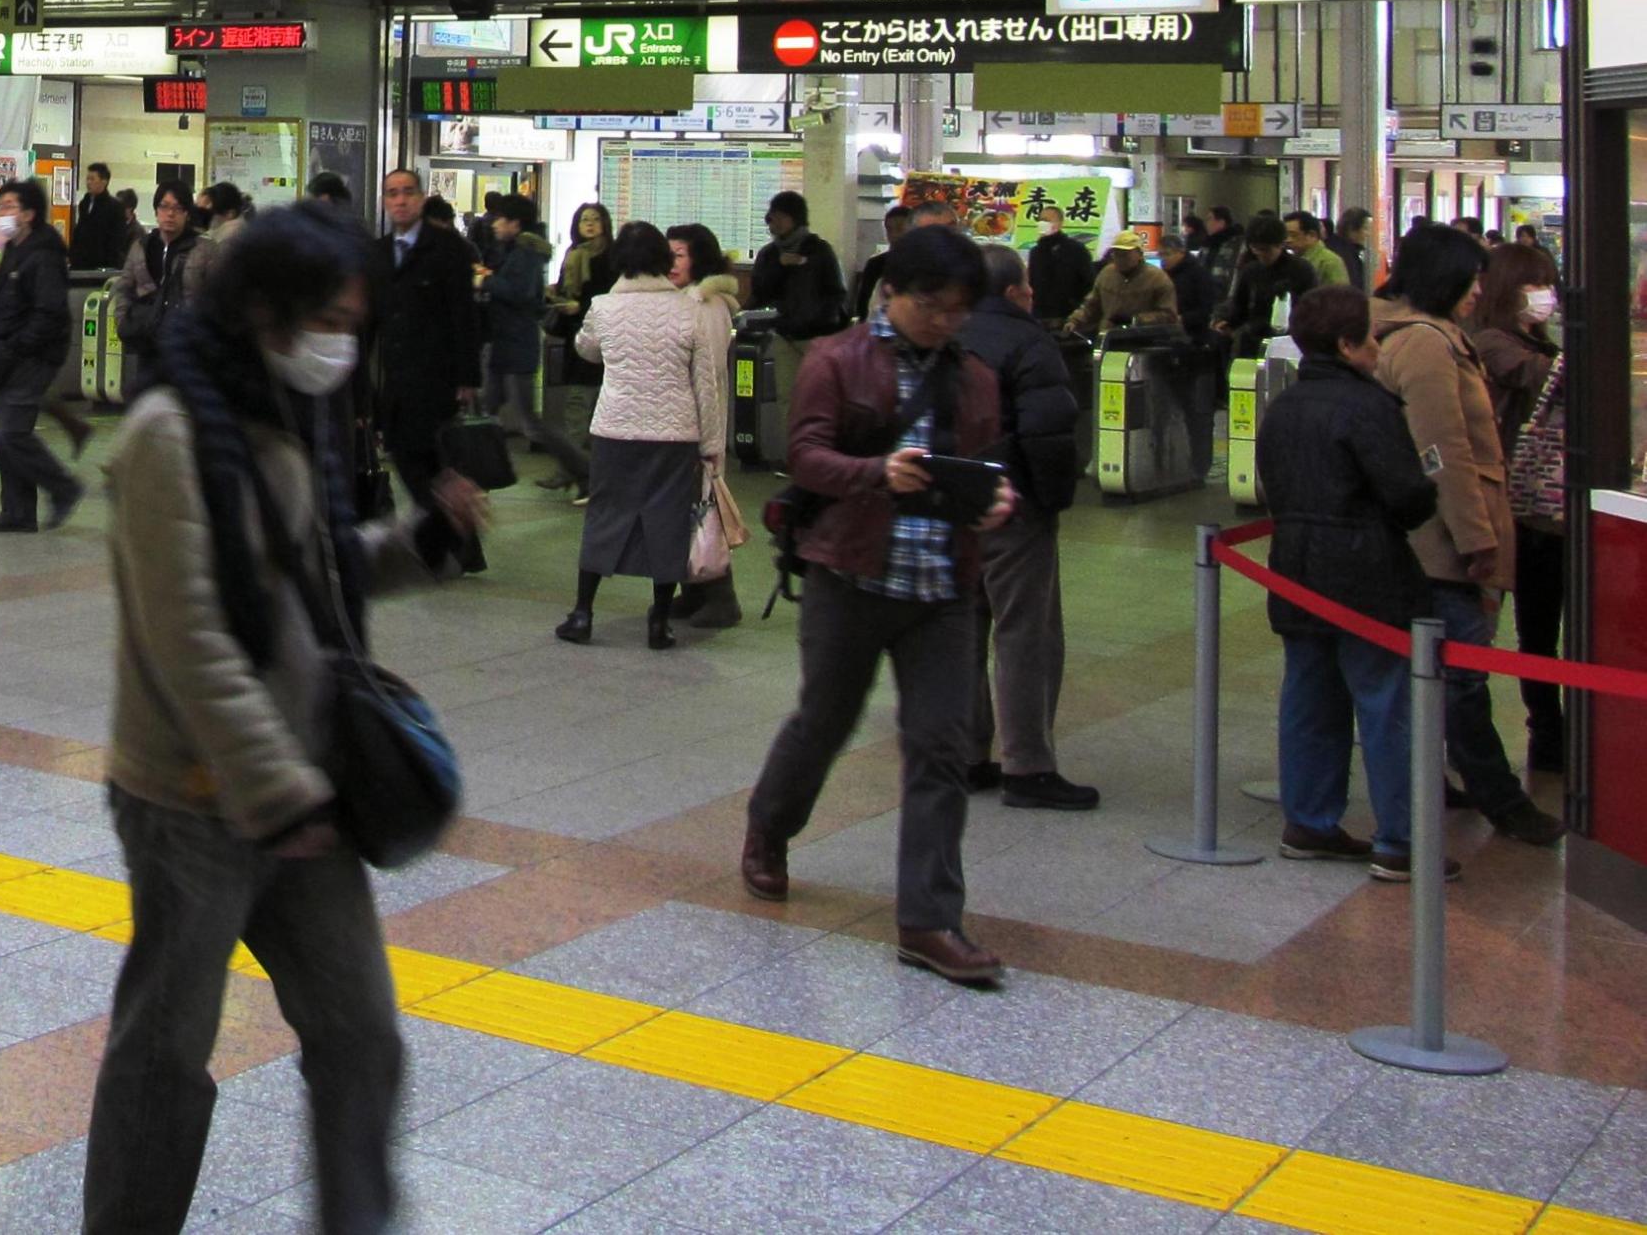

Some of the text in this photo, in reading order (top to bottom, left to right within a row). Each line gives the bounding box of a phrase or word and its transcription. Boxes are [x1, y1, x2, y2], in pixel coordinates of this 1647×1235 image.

[584, 23, 636, 55] JR
[640, 23, 674, 41] 入口
[20, 32, 83, 52] 八王子駅
[639, 43, 683, 54] Entrance
[59, 56, 95, 69] Station
[820, 48, 956, 65] No Entry (Exit Only)
